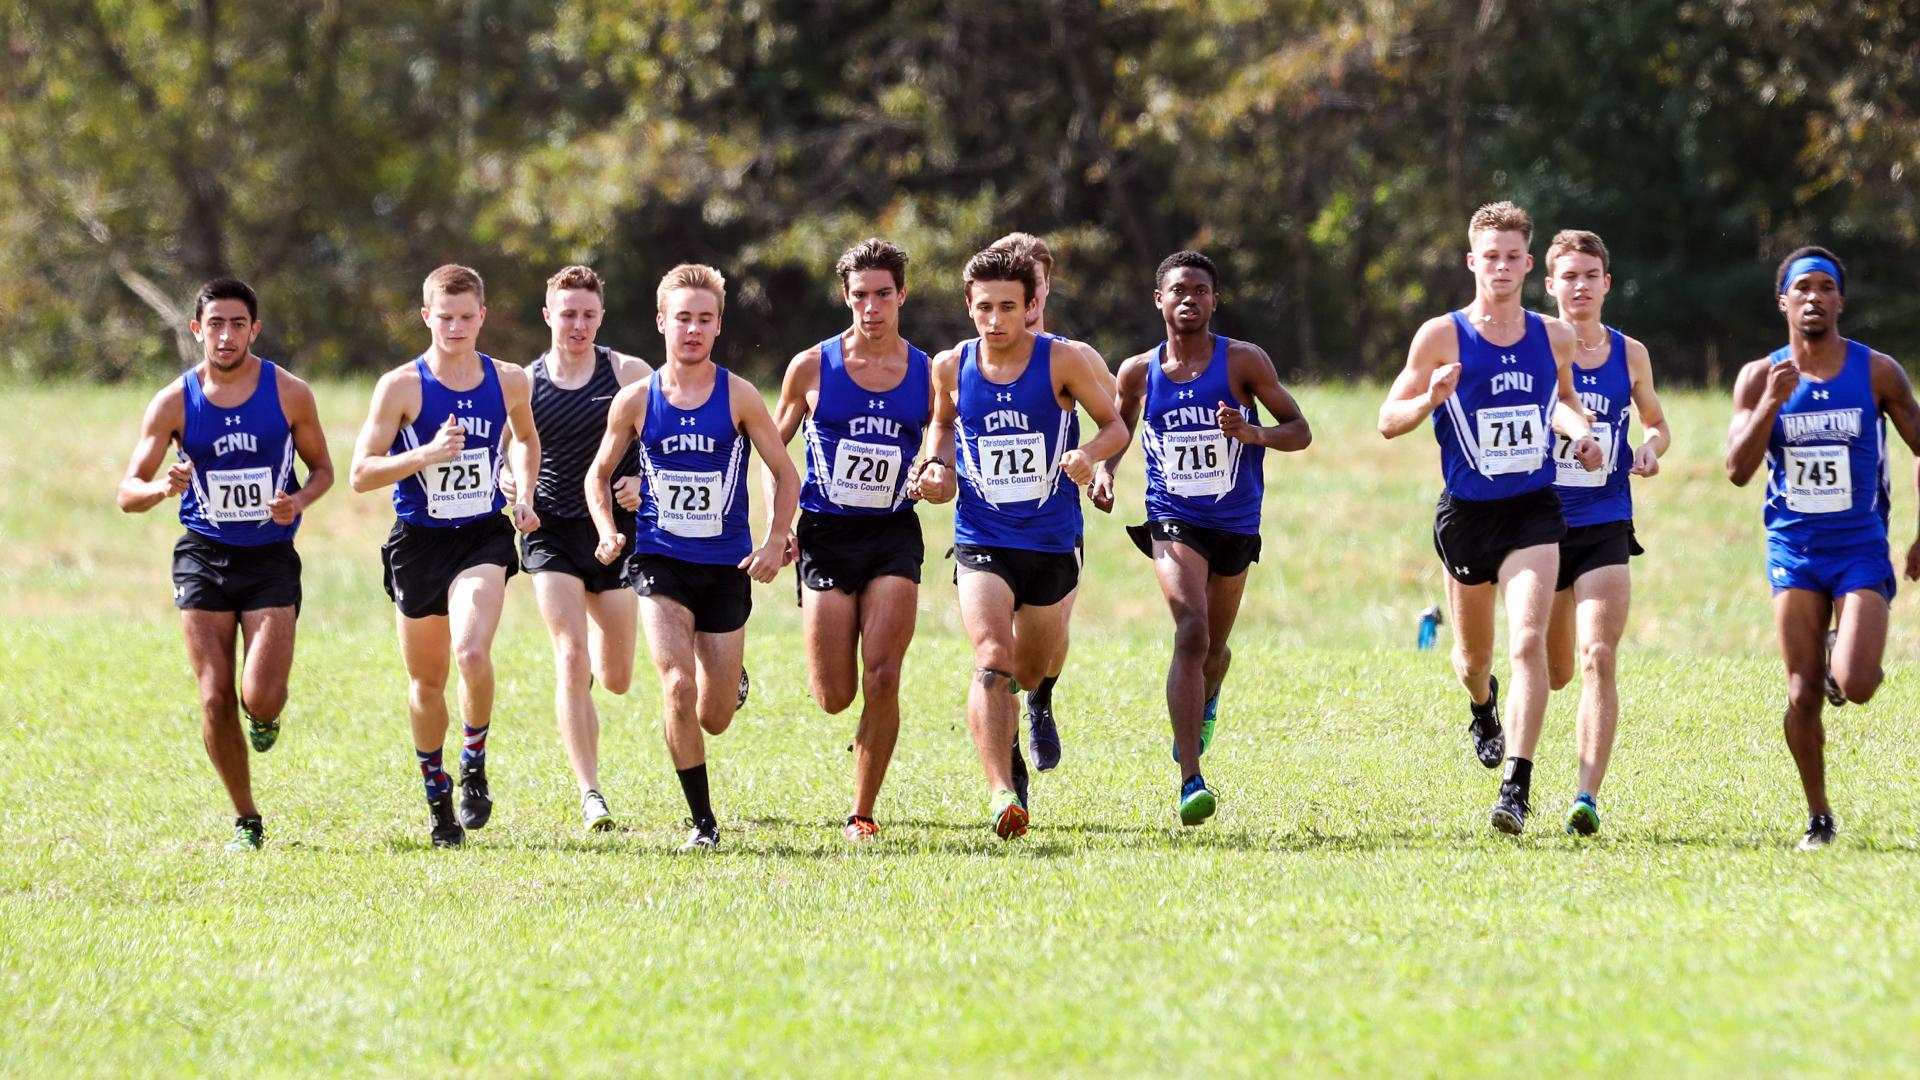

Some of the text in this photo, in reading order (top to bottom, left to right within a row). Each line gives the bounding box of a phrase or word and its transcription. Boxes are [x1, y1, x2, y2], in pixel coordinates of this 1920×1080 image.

[1490, 371, 1534, 396] CNU
[1579, 392, 1611, 416] NU
[439, 416, 492, 439] NU
[848, 416, 903, 438] CNU
[983, 409, 1029, 433] CNU
[1162, 406, 1216, 430] CNU
[1782, 409, 1860, 439] HAMPTON
[213, 432, 258, 457] CNU
[660, 433, 716, 455] CNU
[982, 436, 1041, 448] Christopher Newport
[1167, 432, 1223, 444] Christopher Newport
[1491, 420, 1533, 447] 714
[463, 452, 485, 462] Newport
[842, 442, 898, 457] Christopher Newport
[1174, 444, 1217, 471] 716
[1484, 446, 1539, 457] Cross Country
[845, 454, 889, 483] 720
[990, 448, 1036, 476] 712
[1796, 460, 1838, 486] 745
[438, 464, 481, 492] 725
[661, 473, 718, 485] Christopher Newport
[836, 478, 891, 492] Cross Country
[986, 474, 1043, 486] Cross Country
[1171, 469, 1225, 480] Cross Country
[219, 483, 261, 509] 709
[432, 490, 488, 502] Cross Country
[668, 485, 711, 511] 723
[216, 509, 269, 518] Cross Country
[663, 510, 718, 521] Cross Country
